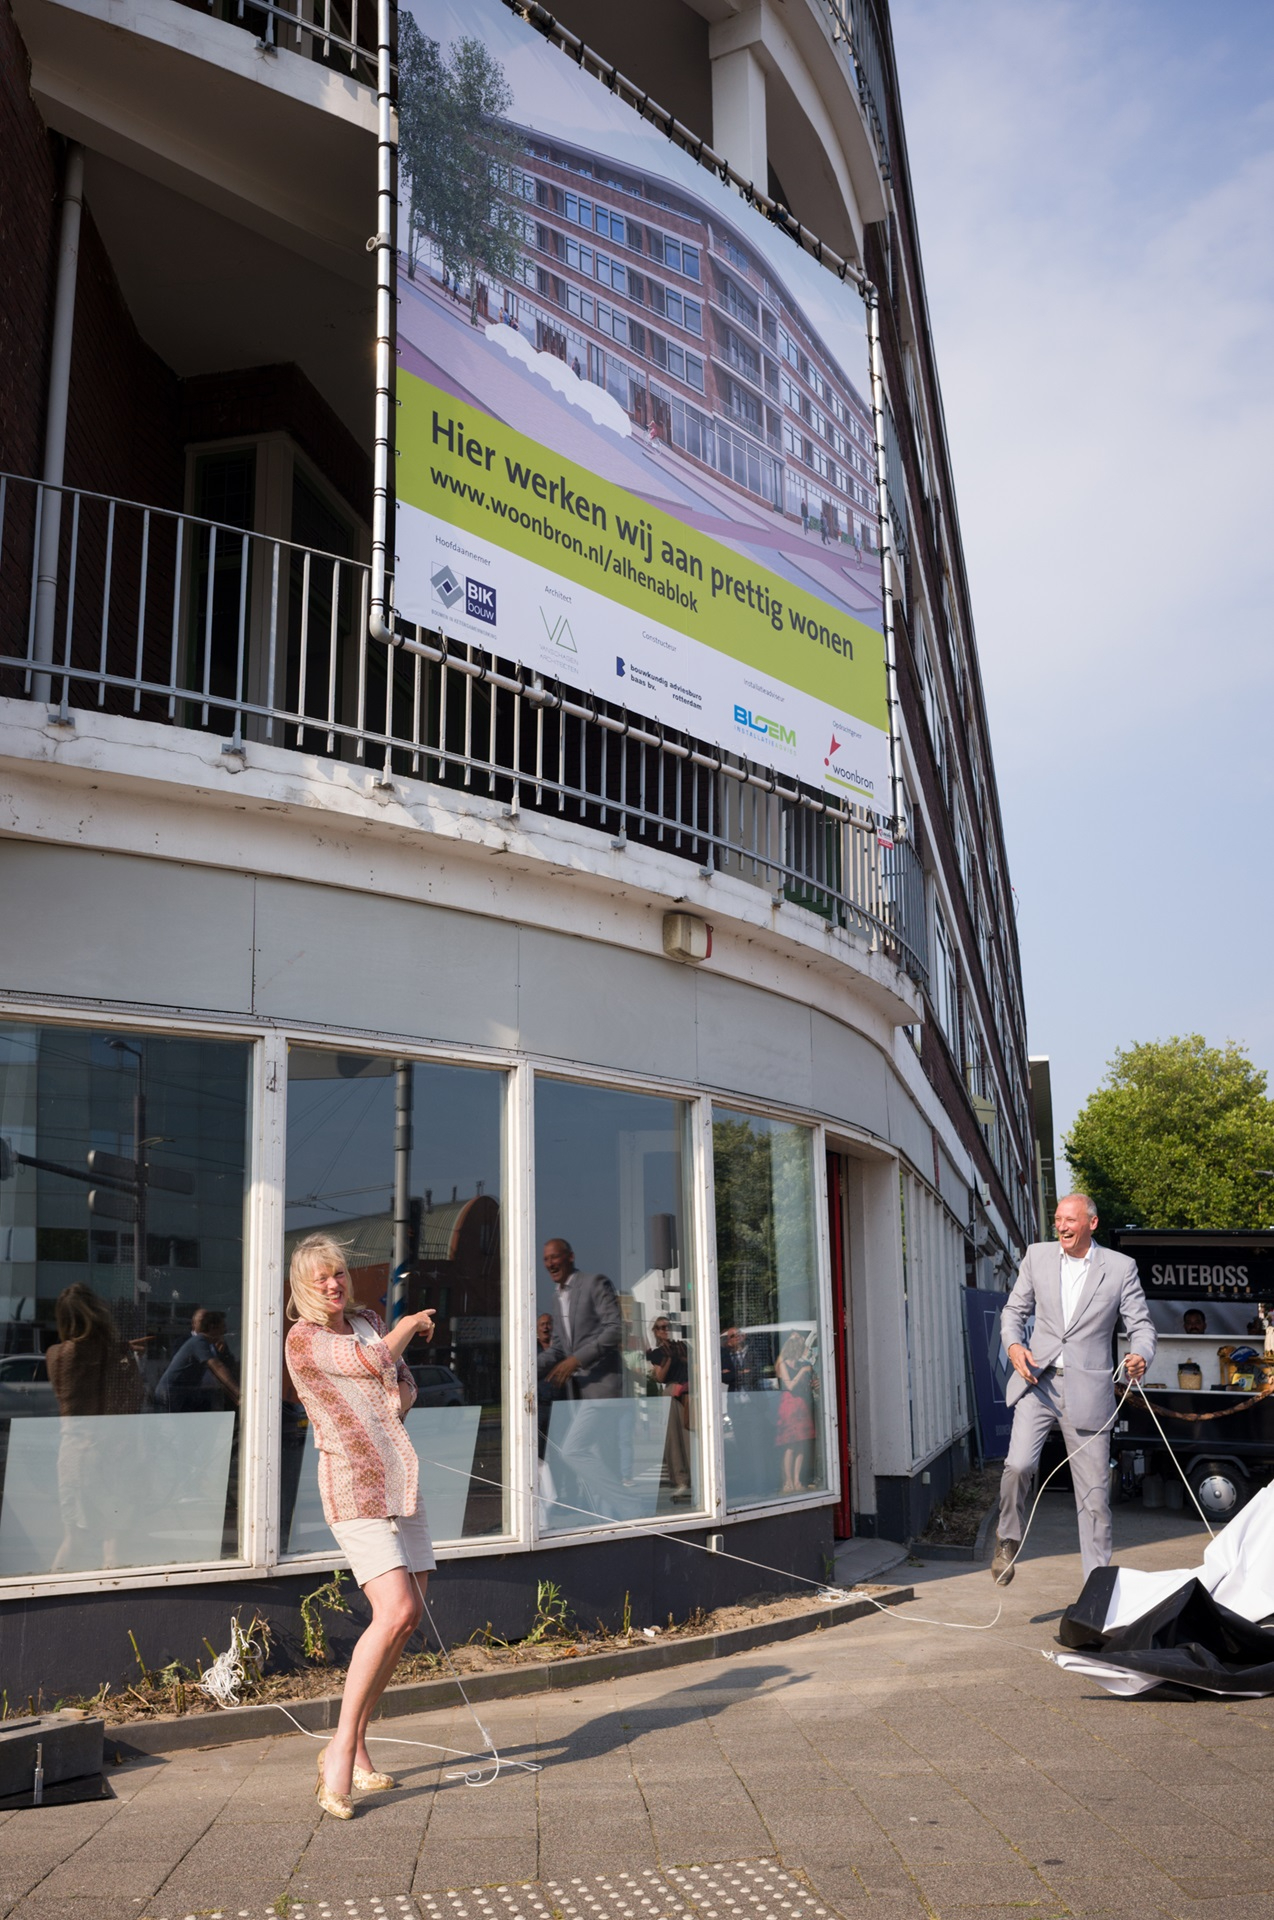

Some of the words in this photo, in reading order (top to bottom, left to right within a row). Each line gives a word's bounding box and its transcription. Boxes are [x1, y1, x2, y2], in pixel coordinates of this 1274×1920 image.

[430, 466, 698, 613] www.woonbron.nl/alhenablok
[432, 410, 496, 471] Hier
[504, 456, 607, 531] werken
[615, 515, 652, 563] wij
[661, 540, 703, 581] aan
[711, 566, 783, 631] prettig
[788, 607, 854, 661] wonen
[435, 535, 491, 566] Hoofdaannemer
[468, 581, 493, 607] BIK
[544, 585, 572, 604] Architect
[468, 599, 494, 620] bouw
[641, 630, 677, 652] Constructeur
[630, 664, 668, 687] bouwkundig
[670, 682, 702, 701] adviesburo
[630, 674, 646, 686] baas
[647, 681, 657, 691] bv.
[672, 693, 702, 710] rotterdam
[733, 703, 796, 748] BLOEM
[832, 764, 874, 790] woonbron
[1151, 1264, 1249, 1287] SATEBOSS
